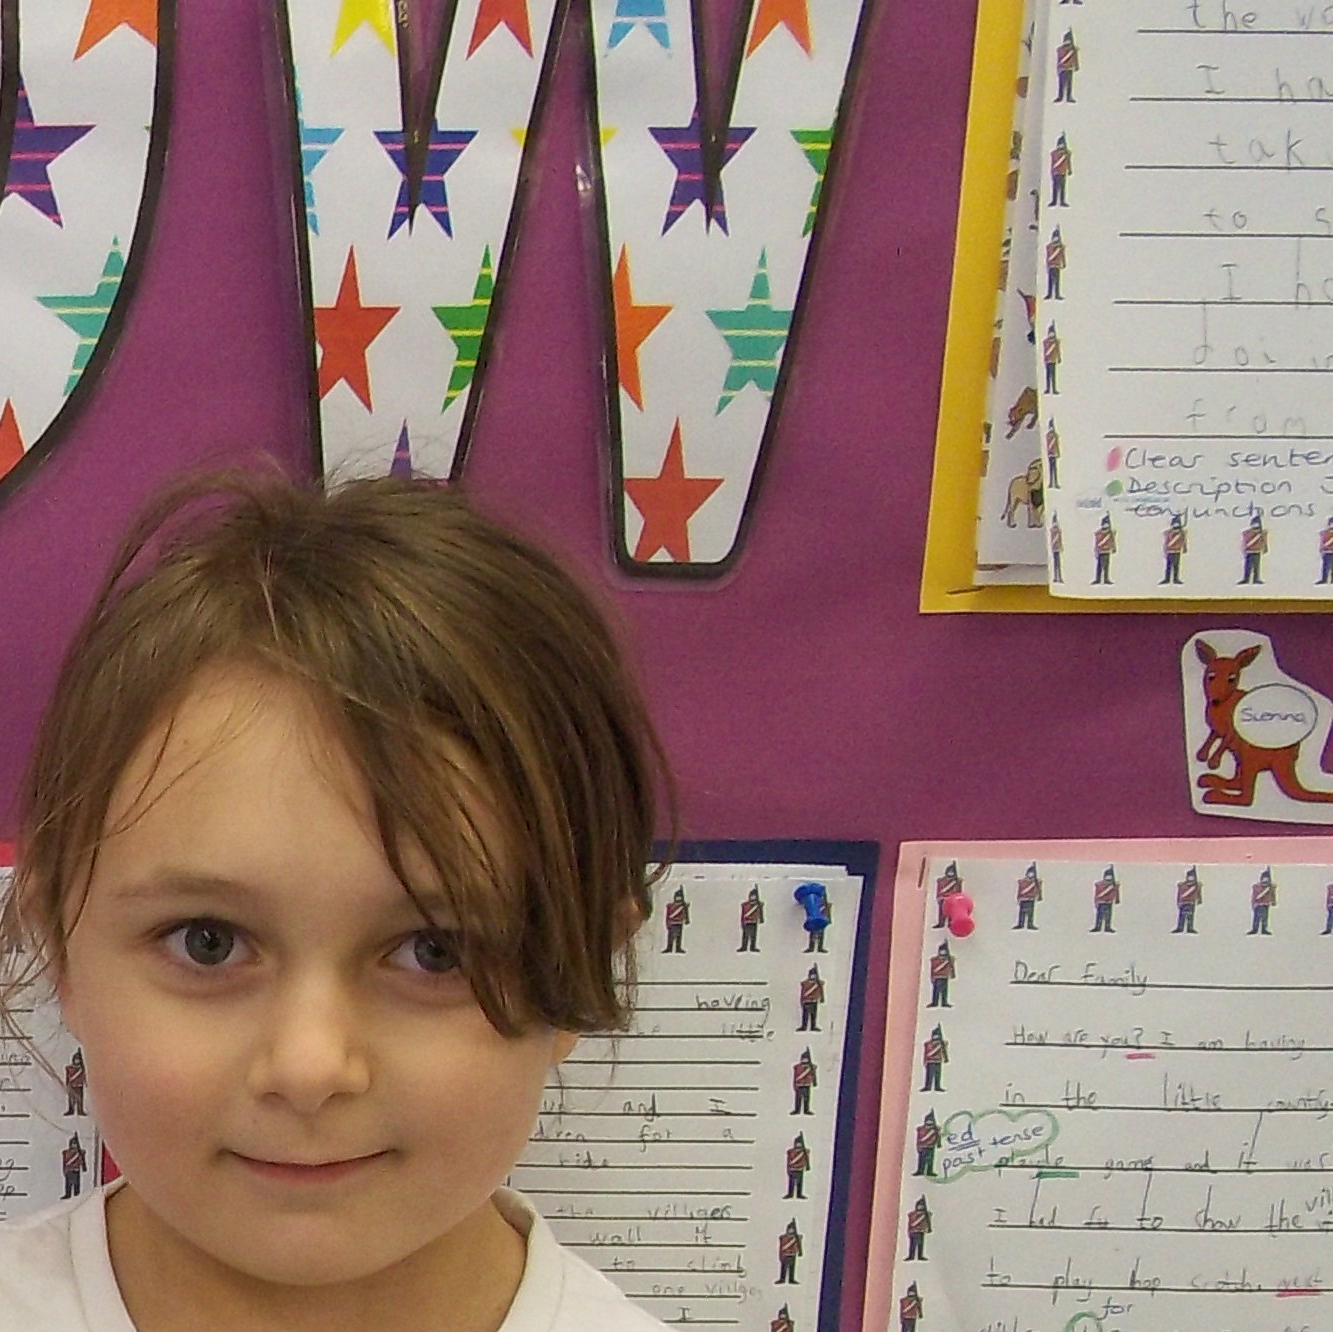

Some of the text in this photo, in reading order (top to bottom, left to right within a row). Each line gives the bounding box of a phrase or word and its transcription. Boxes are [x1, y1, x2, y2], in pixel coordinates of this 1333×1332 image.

[1125, 447, 1333, 469] Clear sente
[1126, 475, 1293, 499] Description
[1013, 960, 1149, 995] Dear Family
[1013, 1024, 1049, 1045] How
[1161, 1030, 1176, 1047] I
[1004, 1072, 1222, 1110] in the little
[947, 1123, 1045, 1148] ed tense
[943, 1147, 985, 1175] past
[985, 1256, 1012, 1286] to
[1102, 1299, 1134, 1323] for
